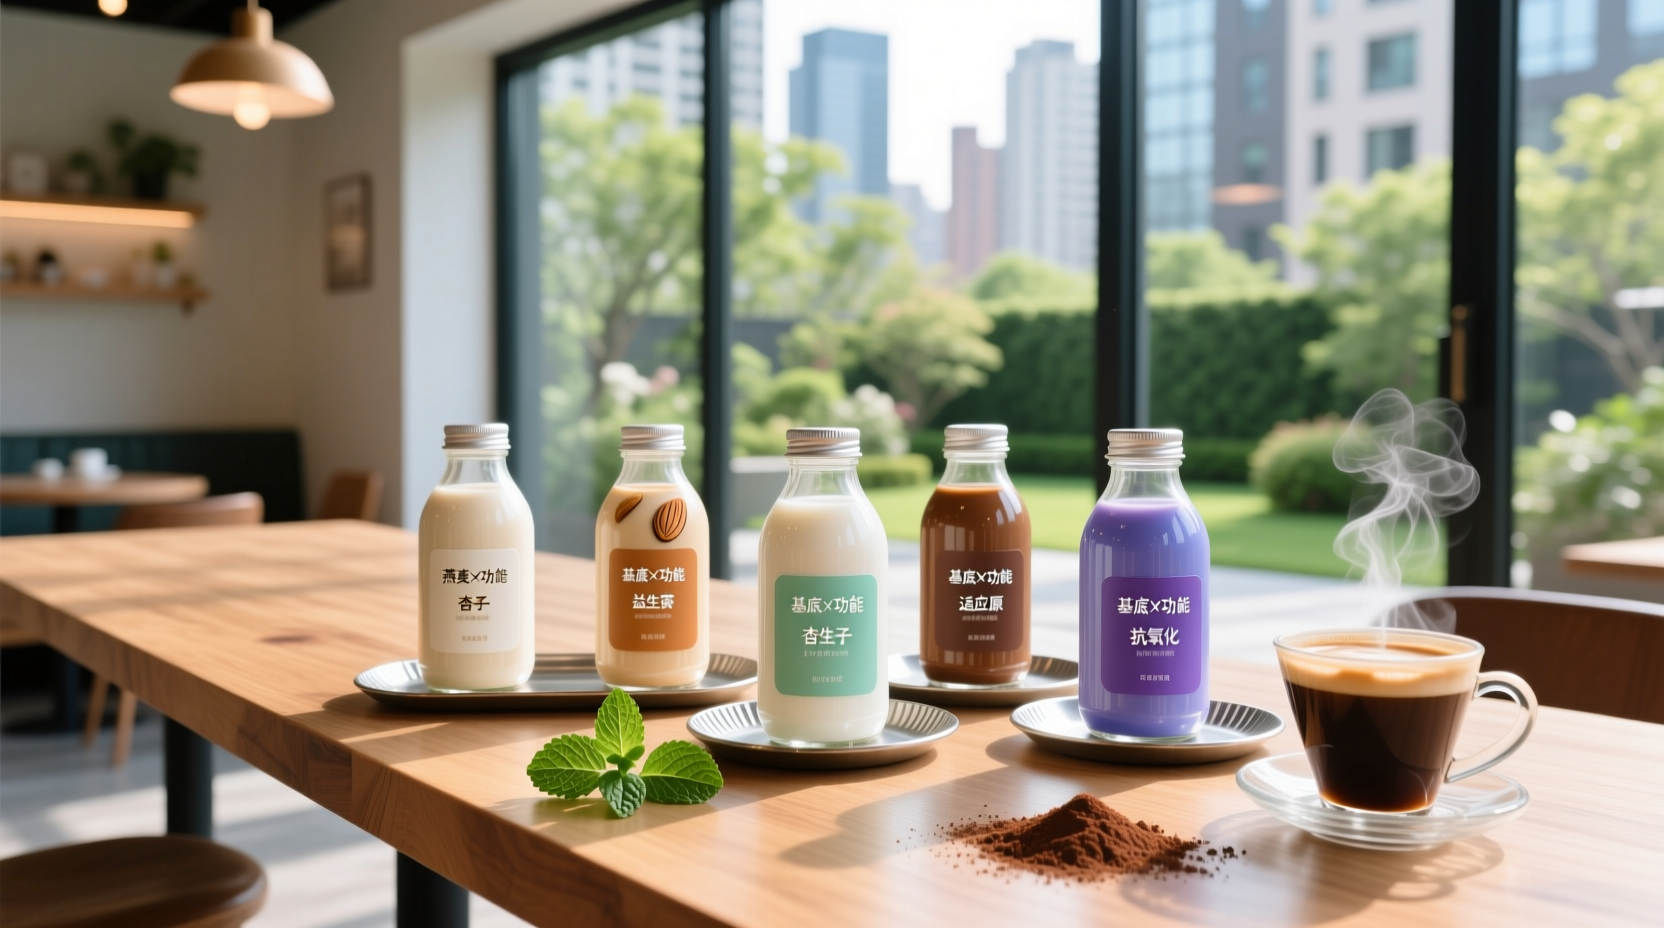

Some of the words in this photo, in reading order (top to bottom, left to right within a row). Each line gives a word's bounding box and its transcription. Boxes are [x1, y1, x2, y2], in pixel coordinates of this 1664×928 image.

[458, 595, 490, 611] 杏子
[801, 626, 852, 646] 杏生子
